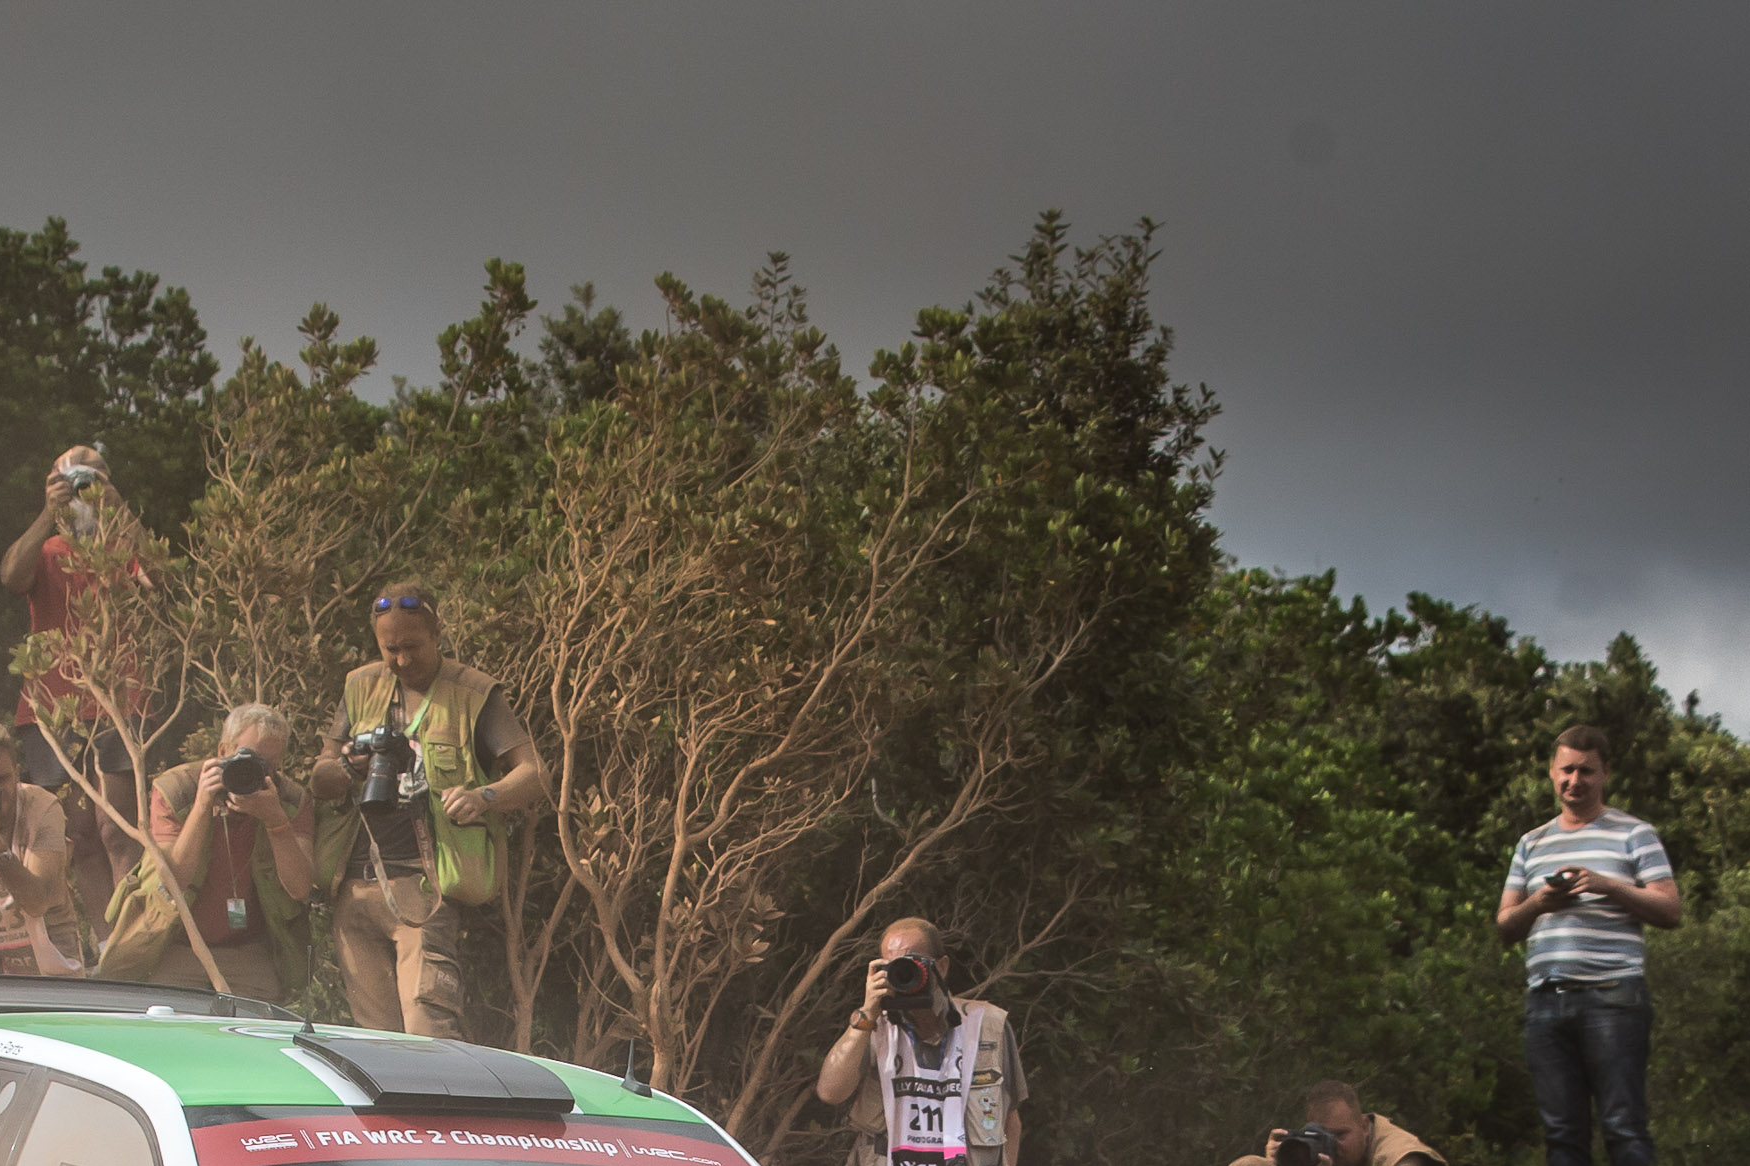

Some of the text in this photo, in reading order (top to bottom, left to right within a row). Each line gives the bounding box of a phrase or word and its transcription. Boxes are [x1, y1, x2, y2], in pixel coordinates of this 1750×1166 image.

[909, 1103, 944, 1133] 211
[240, 1133, 298, 1147] WRC
[315, 1130, 362, 1146] FIA
[362, 1129, 423, 1144] WRC
[426, 1130, 446, 1144] 2
[450, 1130, 619, 1156] Championship
